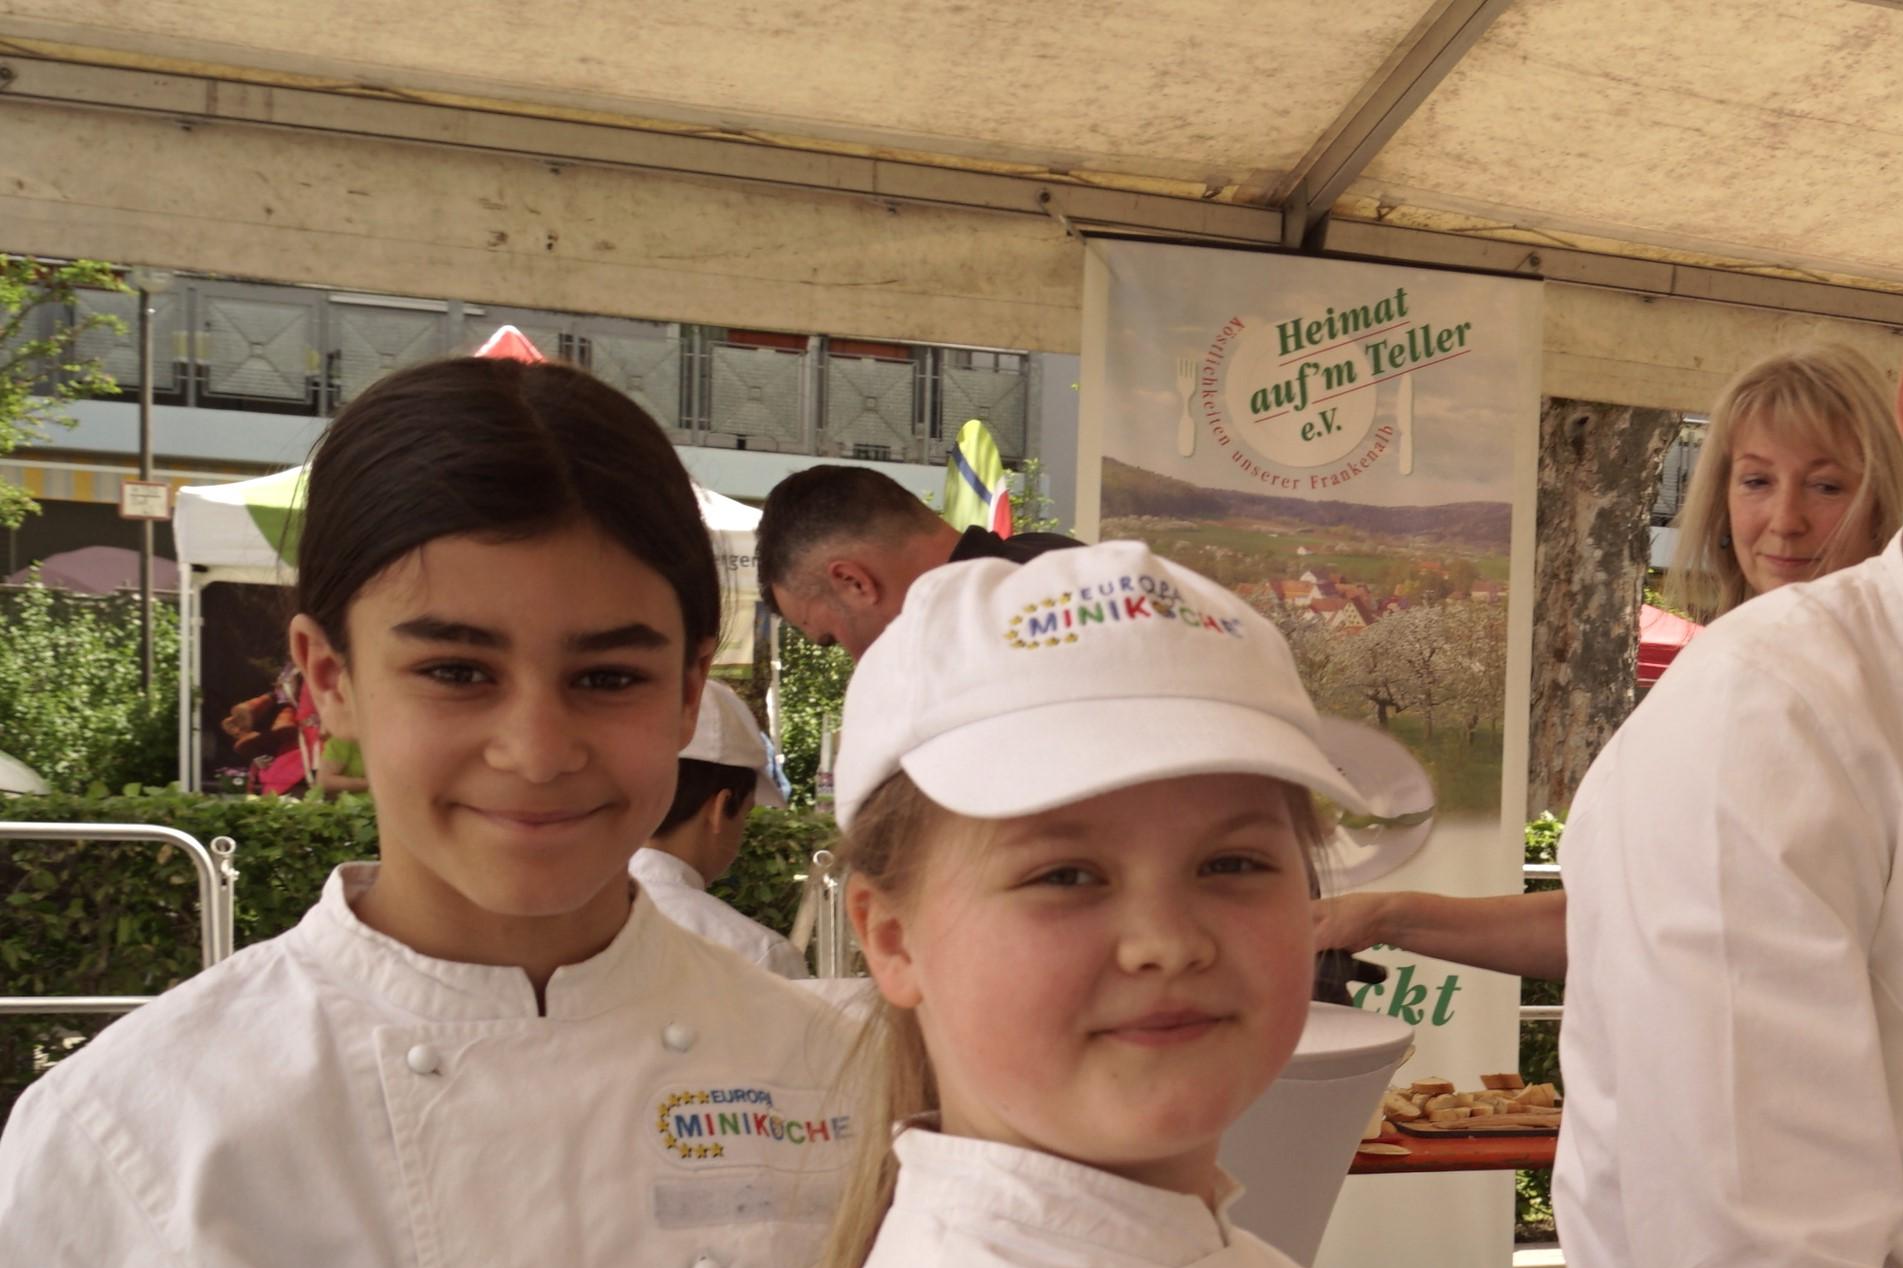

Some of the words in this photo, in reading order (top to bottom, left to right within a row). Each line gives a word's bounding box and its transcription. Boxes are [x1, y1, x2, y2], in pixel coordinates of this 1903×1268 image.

[1276, 288, 1408, 356] Heimat
[1365, 322, 1472, 376] Teller
[1301, 408, 1342, 442] e.V.
[1232, 451, 1300, 490] unserer
[1310, 425, 1393, 490] Frankenalb
[1353, 965, 1462, 1026] ckt
[711, 1089, 773, 1107] EUROPA
